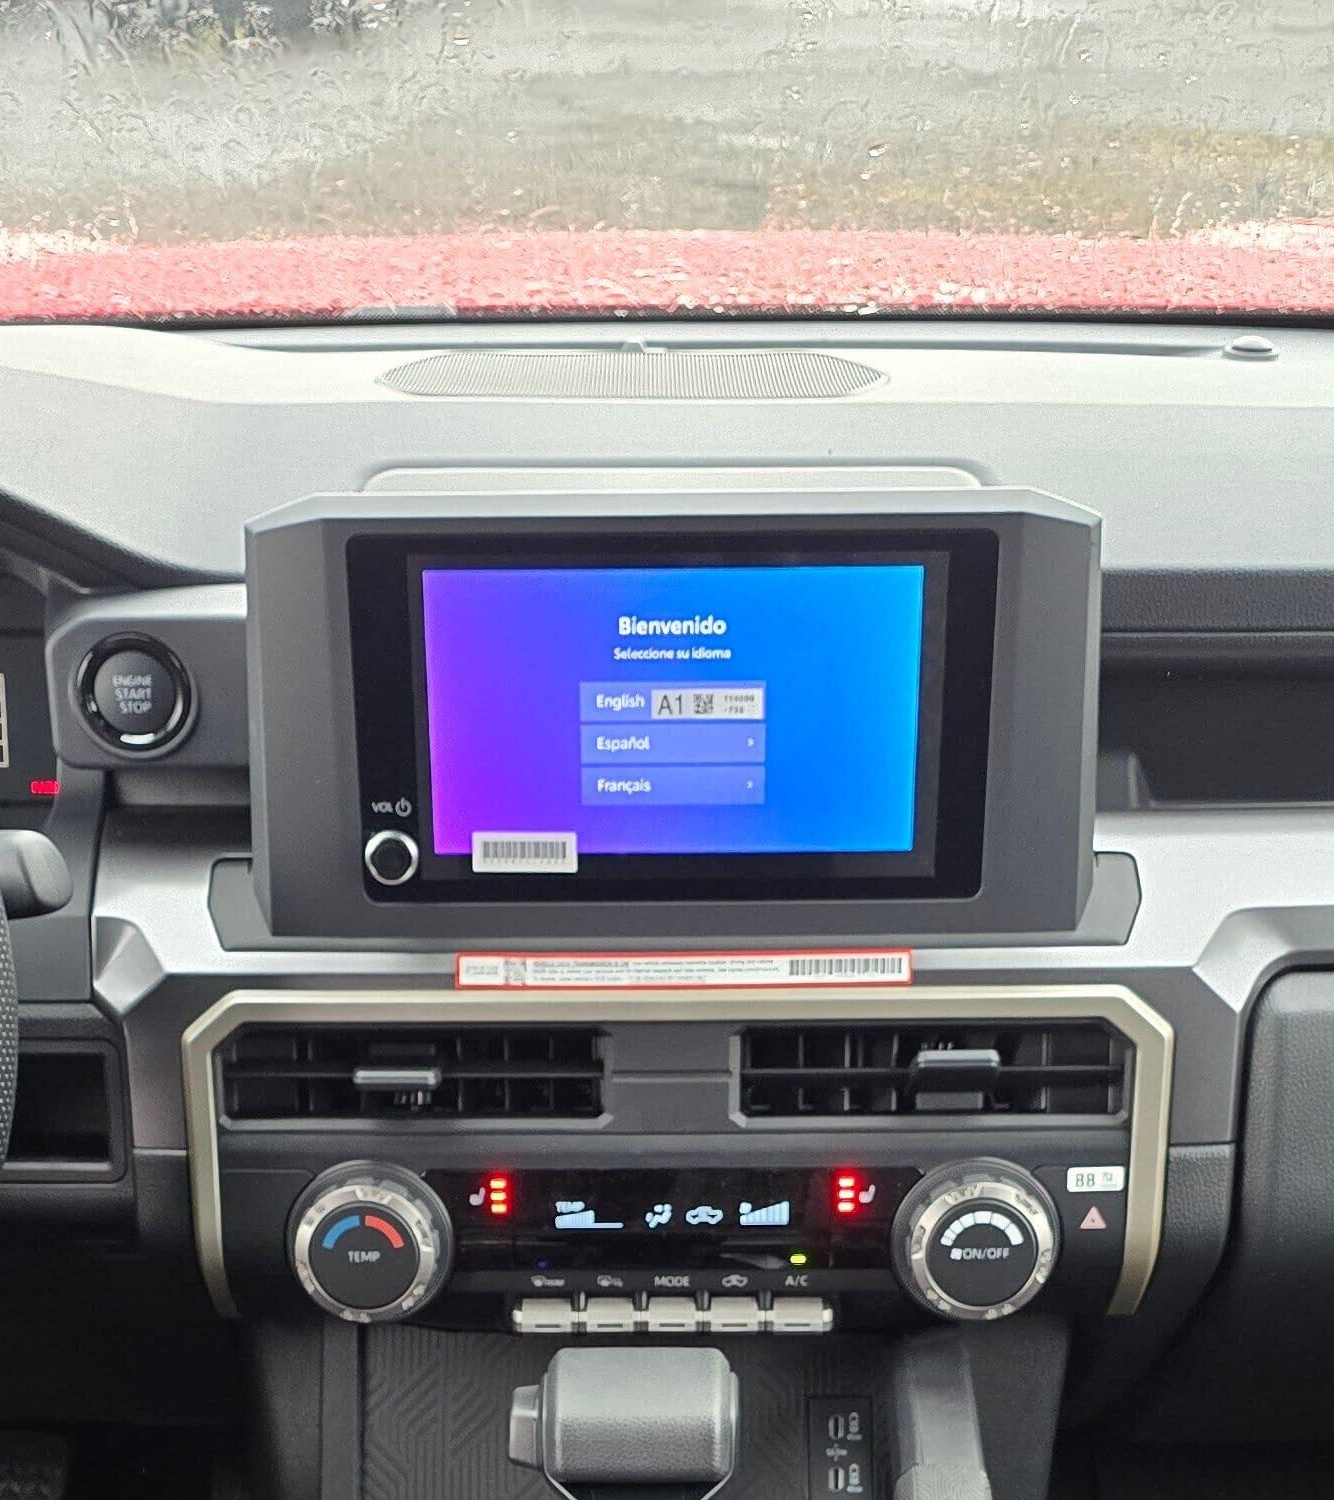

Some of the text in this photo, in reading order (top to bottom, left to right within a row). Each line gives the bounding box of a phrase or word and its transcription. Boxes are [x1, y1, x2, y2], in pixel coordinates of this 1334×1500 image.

[618, 614, 728, 636] Bienvenido
[613, 647, 732, 660] Seleccione su idioma
[112, 674, 153, 688] ENGINE
[114, 688, 153, 700] START
[118, 700, 153, 715] STOP
[595, 693, 646, 710] English
[657, 693, 683, 715] A1
[596, 735, 651, 752] Español
[596, 777, 652, 795] Français
[371, 801, 394, 814] VOL
[347, 1250, 382, 1264] TEMP
[962, 1247, 1011, 1260] ON/OFF
[653, 1275, 691, 1287] MODE
[785, 1275, 809, 1287] A/C
